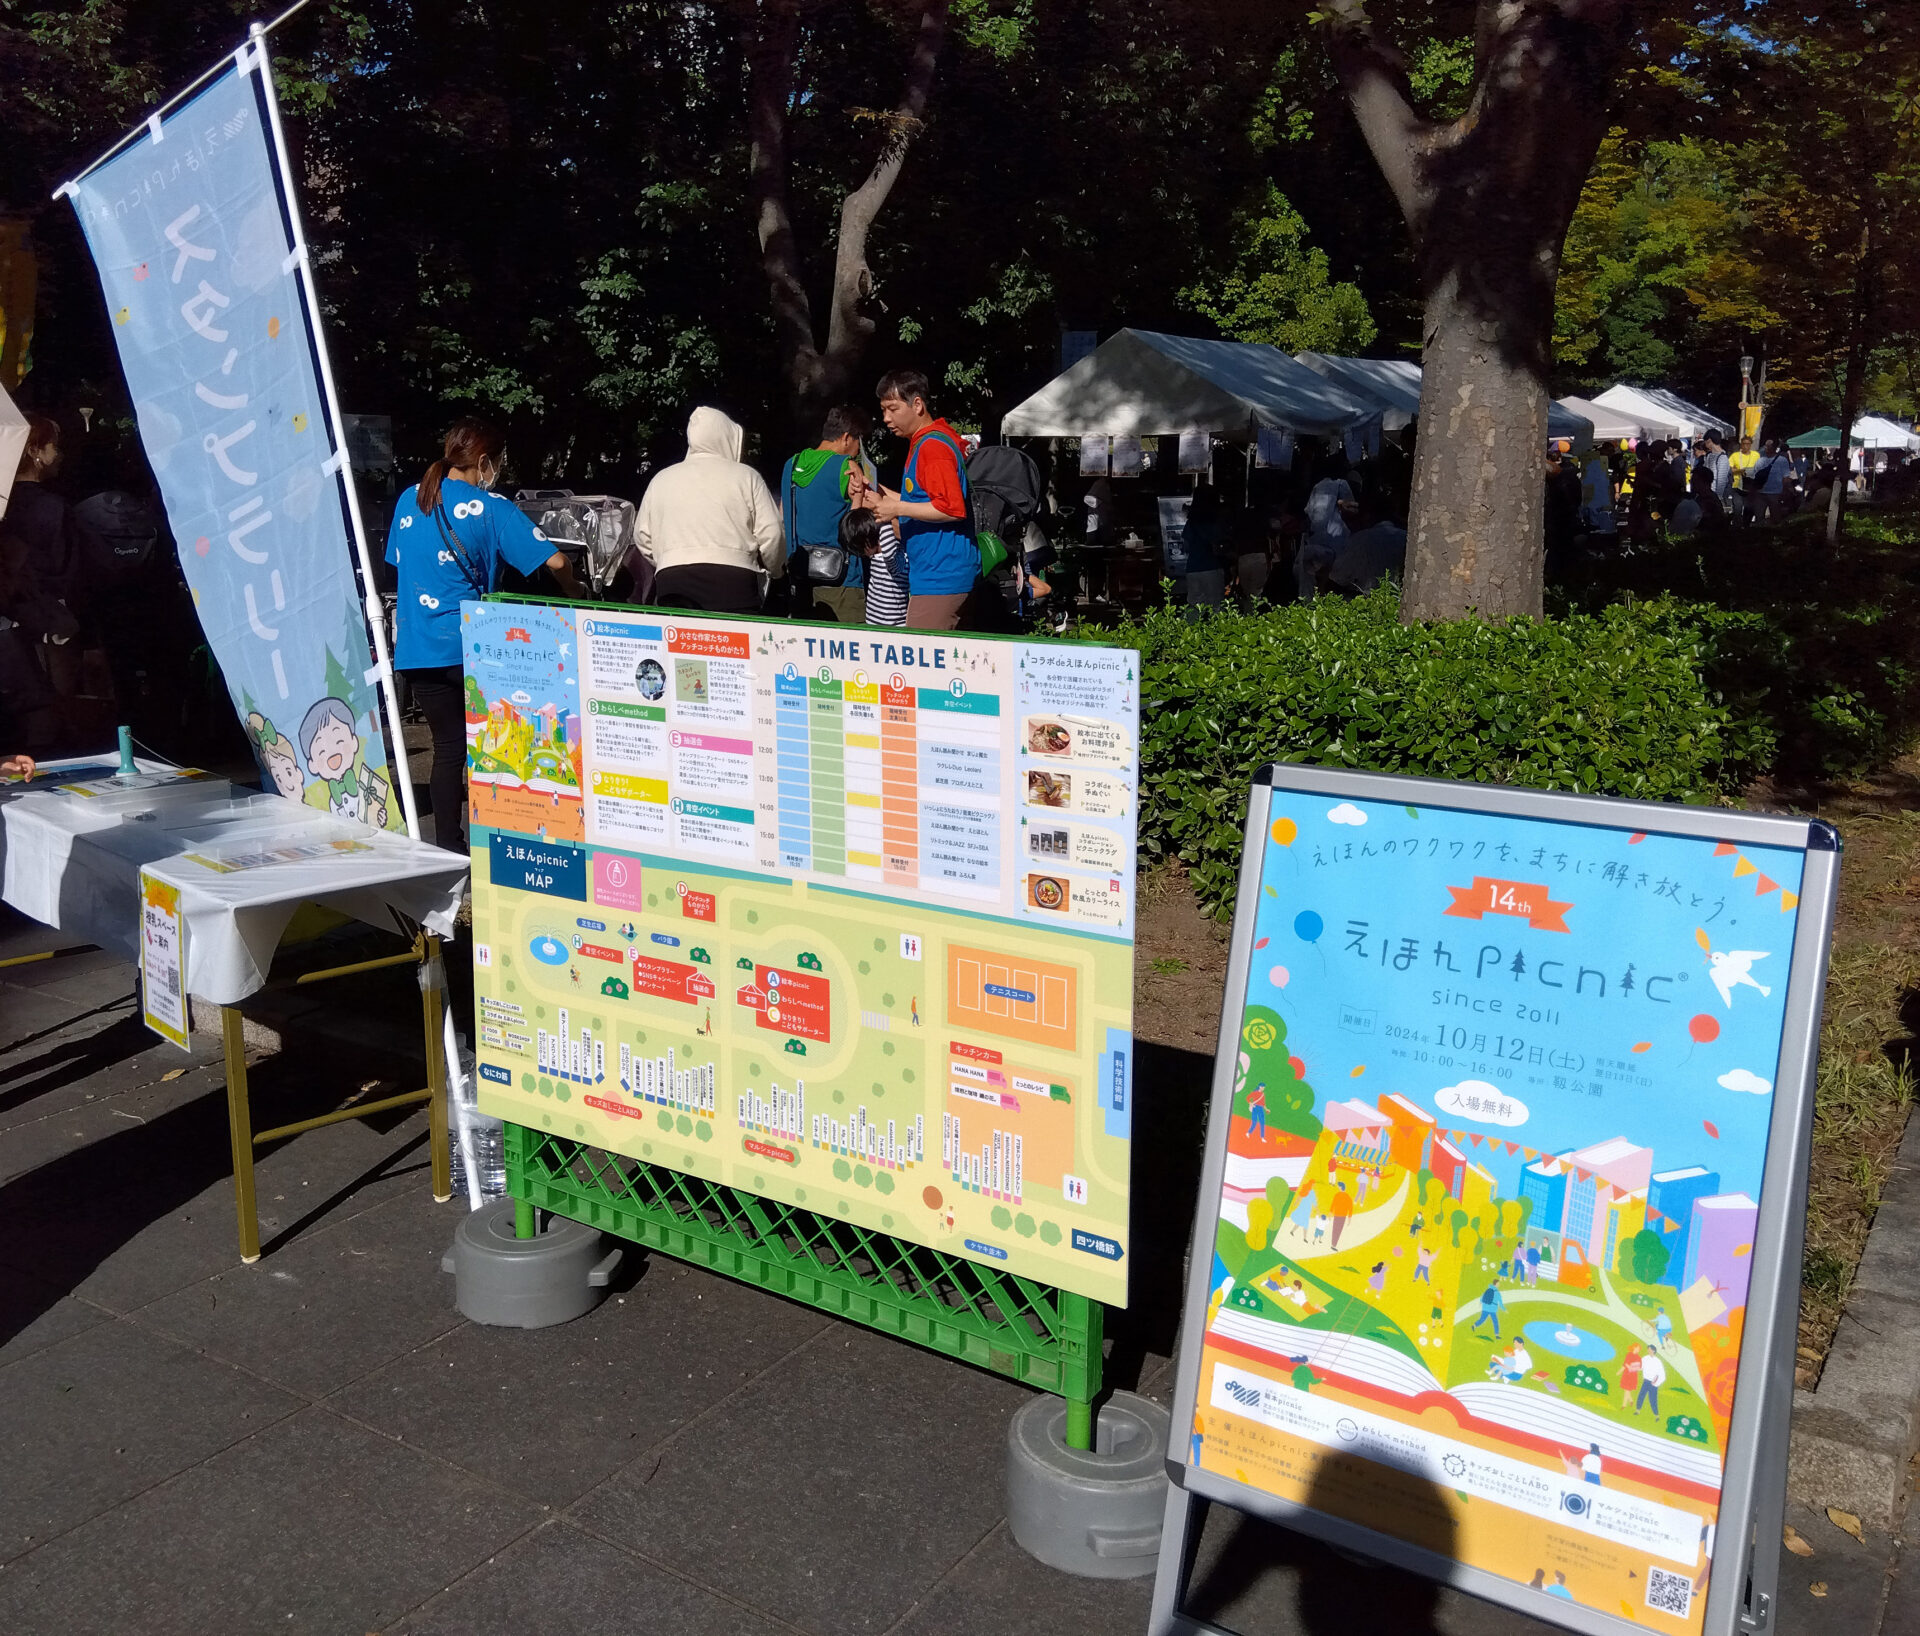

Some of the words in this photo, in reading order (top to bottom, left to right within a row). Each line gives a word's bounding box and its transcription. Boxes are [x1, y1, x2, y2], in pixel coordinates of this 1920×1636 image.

[596, 623, 629, 636] 絵本picnic
[679, 631, 729, 643] 小さな作家たちの
[680, 641, 745, 655] アッチコッチものがたり
[803, 637, 860, 662] TIME
[869, 642, 946, 669] TABLE
[1030, 654, 1120, 672] コラボdeえほんpicnic
[785, 665, 795, 679] A
[821, 668, 830, 682] B
[854, 671, 865, 686] C
[893, 675, 903, 689] D
[952, 680, 963, 695] H
[756, 688, 771, 697] 10:00
[600, 703, 648, 717] わらしべmethod
[757, 717, 772, 725] 11:00
[683, 735, 703, 747] 抽選会
[1076, 728, 1121, 740] 絵本に出てくる
[757, 745, 773, 754] 12:00
[1081, 737, 1115, 748] お料理弁当
[758, 774, 773, 783] 13:00
[1084, 780, 1111, 790] コラボde
[1084, 788, 1111, 798] 手ぬぐい
[685, 802, 720, 817] 青空イベント
[758, 802, 774, 811] 14:00
[759, 830, 774, 840] 15:00
[1075, 843, 1117, 856] ピクニックラグ
[504, 844, 569, 870] えほんpicnic
[759, 858, 775, 868] 16:00
[524, 871, 553, 890] MAP
[1310, 838, 1737, 926] えほんのワクワクを、まちに解き放とう。
[1084, 887, 1108, 898] とっとの
[1486, 883, 1534, 915] 14th
[581, 919, 601, 930] 芝生広場
[656, 934, 673, 945] バラ園
[584, 946, 615, 960] 青空イベント
[641, 980, 666, 991] アンケート
[692, 982, 710, 994] 抽選会
[781, 976, 810, 990] 絵本picnic
[744, 994, 757, 1005] 本部
[990, 985, 1031, 1001] テニスコート
[781, 995, 824, 1011] わらしべmethod
[1431, 985, 1503, 1017] since
[1515, 1002, 1560, 1027] 2011
[954, 1044, 998, 1061] キッチンカー
[483, 1066, 508, 1082] なにわ筋
[1113, 1058, 1124, 1104] 科学技術館
[586, 1096, 638, 1118] キッズおしごとLABO
[1449, 1091, 1515, 1119] 入場無料
[970, 1241, 1002, 1258] ケヤキ並木
[1075, 1234, 1115, 1256] 四ツ橋筋
[1263, 1391, 1302, 1412] 絵本picnic
[1361, 1423, 1426, 1452] わらしべmethod
[1468, 1459, 1549, 1492] キッズおしごとLABO
